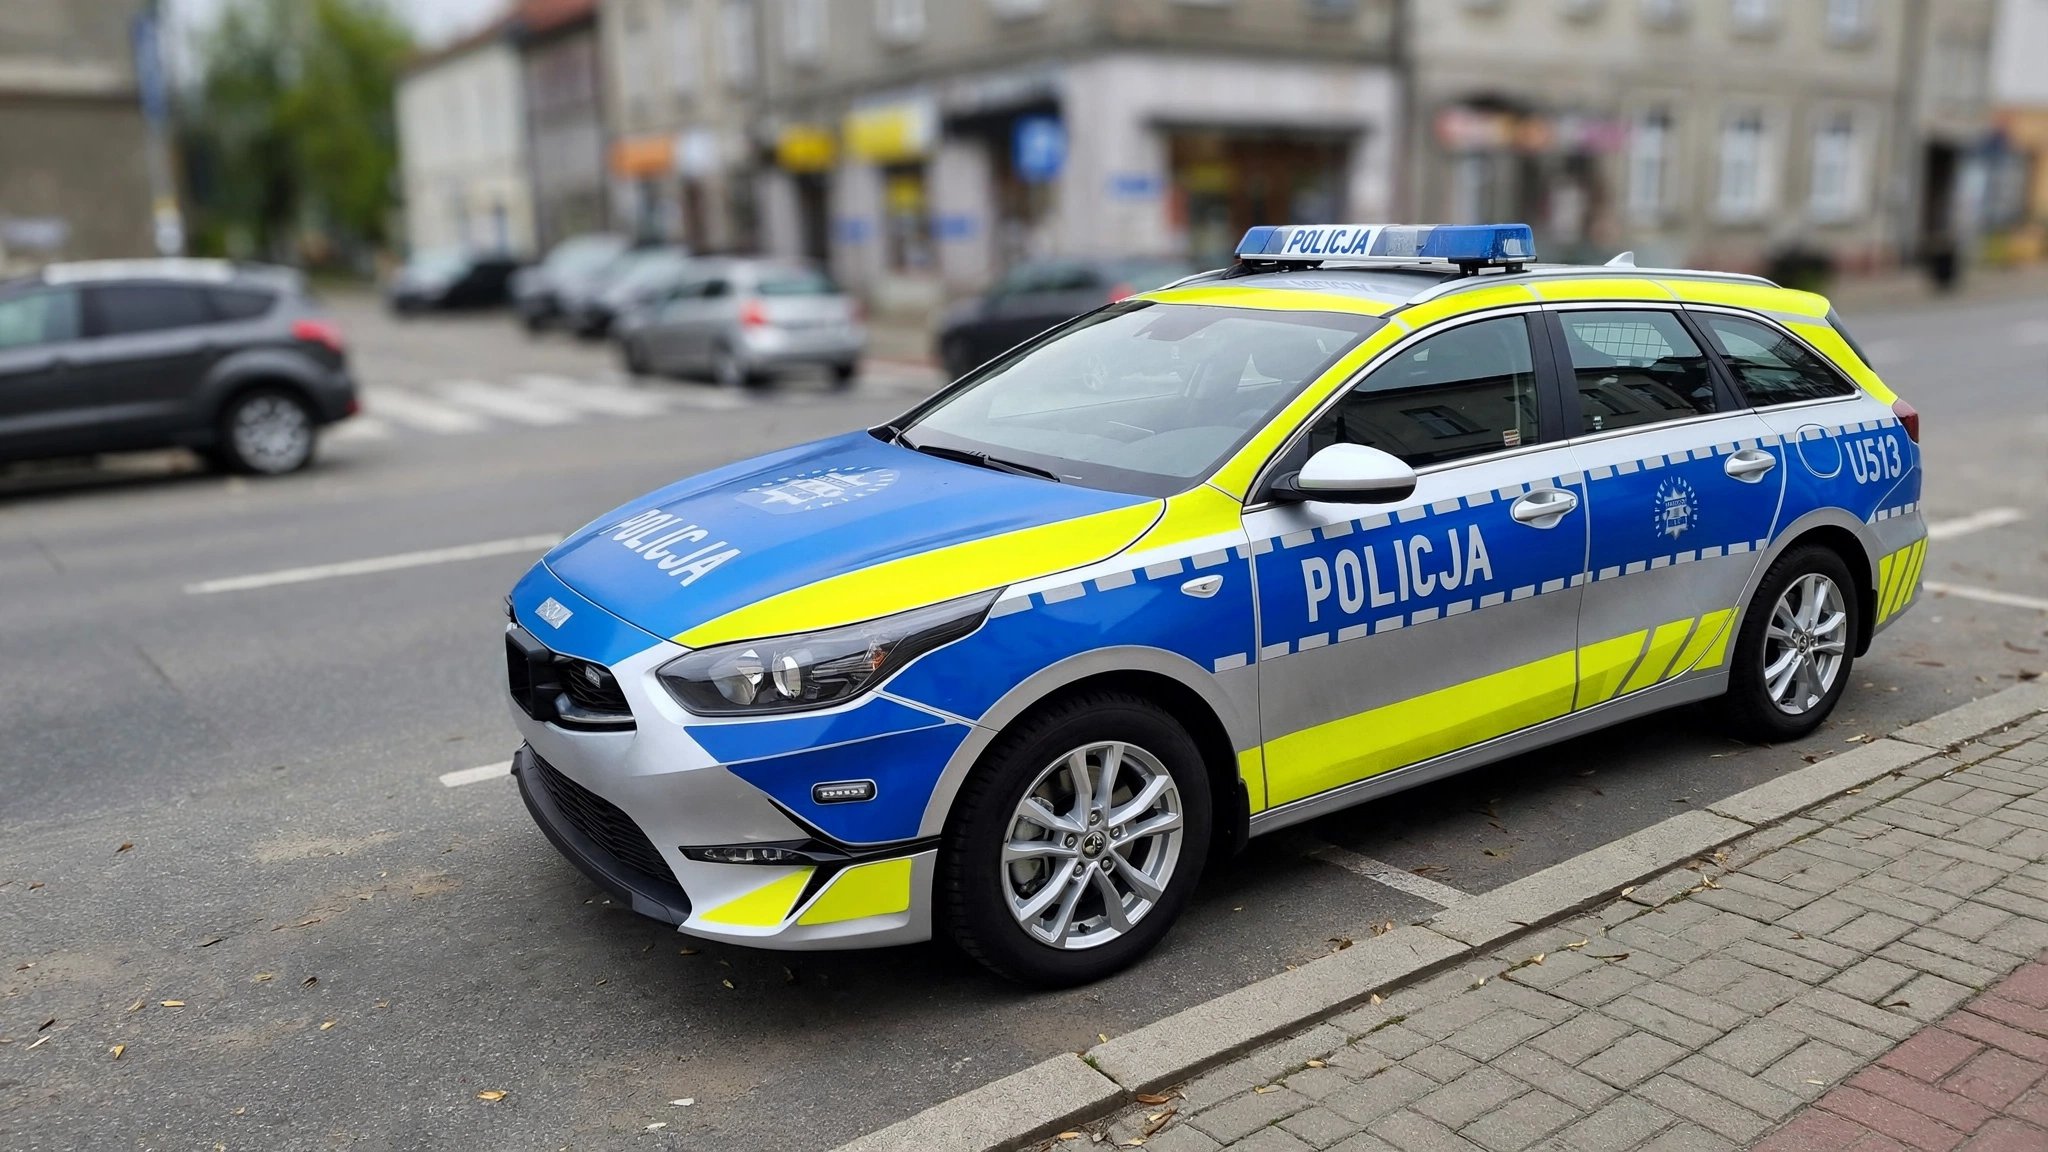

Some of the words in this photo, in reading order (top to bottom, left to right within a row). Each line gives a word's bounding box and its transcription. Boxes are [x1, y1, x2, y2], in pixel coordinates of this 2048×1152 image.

[1287, 229, 1371, 254] POLICJA
[1844, 434, 1902, 485] U513
[598, 508, 741, 587] POLICJA
[1301, 524, 1493, 622] POLICJA
